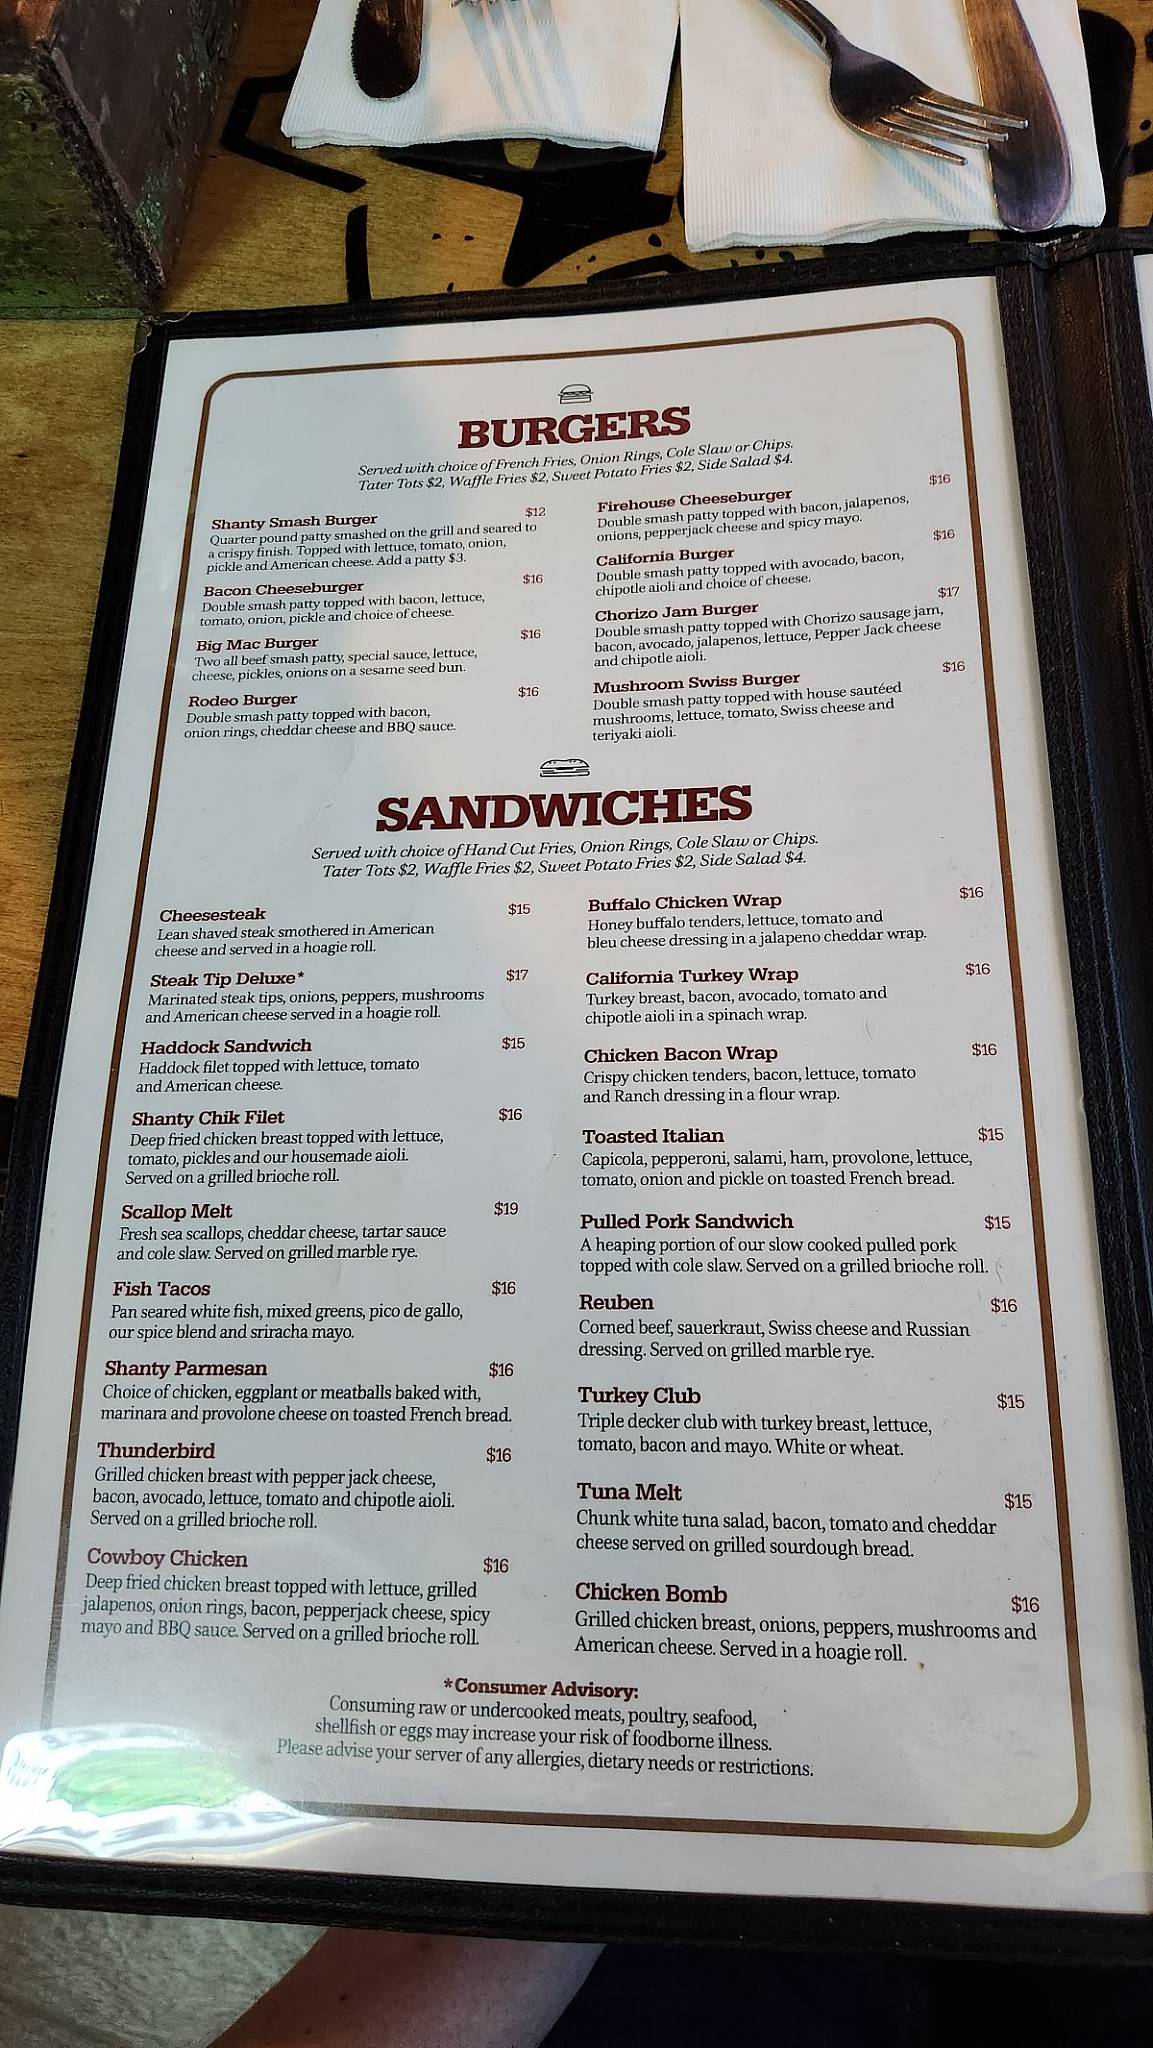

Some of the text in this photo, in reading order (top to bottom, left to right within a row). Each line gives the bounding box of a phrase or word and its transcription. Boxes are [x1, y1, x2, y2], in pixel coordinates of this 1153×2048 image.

[457, 405, 691, 450] BURGERS
[357, 438, 794, 477] Served with choice of French Fries, Onion Rings, Cole Slaw or Chips.
[928, 473, 951, 487] $16
[596, 490, 793, 513] Firehouse Cheeseburger
[524, 506, 546, 518] $12
[211, 514, 379, 532] Shanty Smash Burger
[209, 521, 537, 547] Quarter pound patty smashed on the grill and seared to
[932, 528, 956, 542] $16
[595, 548, 735, 567] California Burger
[522, 573, 544, 585] $16
[202, 581, 365, 598] Bacon Cheeseburger
[937, 585, 960, 599] $17
[594, 603, 760, 622] Chorizo Jam Burger
[595, 605, 944, 638] Double smash patty topped with Chorizo sausage jam,
[520, 628, 542, 641] $16
[195, 637, 320, 654] Big Mac Burger
[942, 660, 966, 674] $16
[517, 685, 540, 699] $16
[592, 674, 801, 694] Mushroom Swiss Burger
[187, 694, 299, 709] Rodeo Burger
[592, 725, 677, 744] teriyaki aioli.
[375, 784, 753, 833] SANDWICHES
[959, 885, 985, 901] $16
[507, 902, 531, 917] $15
[587, 893, 783, 913] Buffalo Chicken Wrap
[159, 907, 267, 923] Cheesesteak
[505, 968, 529, 983] $17
[585, 967, 799, 986] California Turkey Wrap
[964, 961, 991, 977] $16
[149, 973, 200, 988] Steak
[202, 972, 233, 990] Tip
[139, 1038, 313, 1056] Haddock Sandwich
[501, 1036, 526, 1051] $15
[971, 1041, 998, 1058] $16
[583, 1045, 778, 1064] Chicken Bacon Wrap
[131, 1109, 286, 1129] Shanty Chik Filet
[498, 1107, 523, 1123] $16
[581, 1127, 726, 1145] Toasted Italian
[977, 1125, 1004, 1144] $15
[581, 1148, 973, 1170] Capicola, pepperoni, salami, ham, provolone, lettuce,
[120, 1203, 234, 1223] Scallop Melt
[493, 1200, 519, 1218] $19
[579, 1212, 795, 1230] Pulled Pork Sandwich
[984, 1214, 1012, 1232] $15
[118, 1224, 447, 1245] Fresh sea scallops, cheddar cheese, tartar sauce
[112, 1280, 212, 1297] Fish Tacos
[491, 1279, 517, 1297] $16
[578, 1293, 655, 1311] Reuben
[990, 1297, 1018, 1315] $16
[104, 1359, 268, 1380] Shanty Parmesan
[488, 1360, 514, 1379] $16
[577, 1386, 702, 1408] Turkey Club
[996, 1391, 1026, 1411] $15
[96, 1441, 216, 1460] Thunderbird
[486, 1445, 512, 1464] $16
[576, 1482, 683, 1502] Tuna Melt
[1004, 1491, 1033, 1512] $15
[87, 1547, 249, 1570] Cowboy Chicken
[482, 1556, 510, 1575] $16
[575, 1581, 728, 1604] Chicken Bomb
[1010, 1594, 1040, 1615] $16
[574, 1609, 1038, 1641] Grilled chicken breast, onions, peppers, mushrooms and
[550, 1680, 639, 1703] Advisory:
[329, 1694, 758, 1730] Consuming raw or undercooked meats, poultry, seafood,
